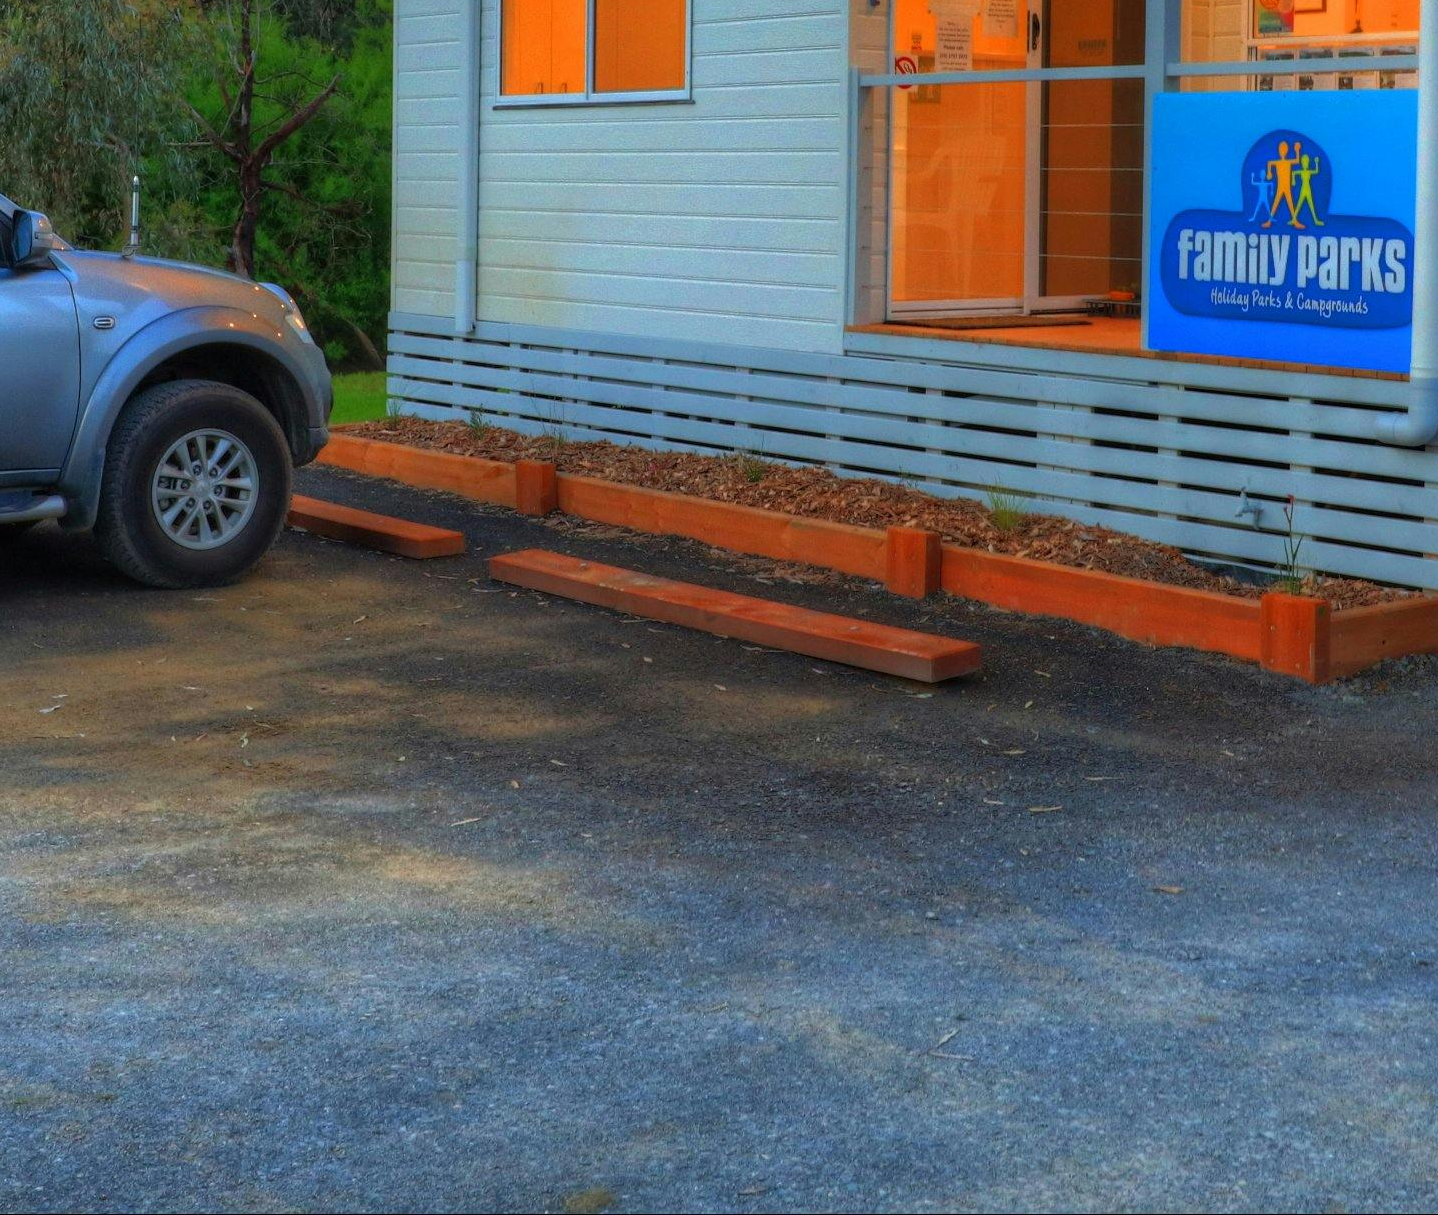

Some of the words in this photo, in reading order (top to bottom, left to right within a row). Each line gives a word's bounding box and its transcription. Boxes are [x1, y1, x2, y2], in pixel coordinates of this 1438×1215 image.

[1177, 228, 1290, 286] family
[1297, 235, 1406, 294] parks
[1211, 287, 1249, 312] Holiday
[1252, 289, 1282, 308] Parks
[1285, 293, 1294, 310] &
[1297, 292, 1369, 318] Campgrounds
